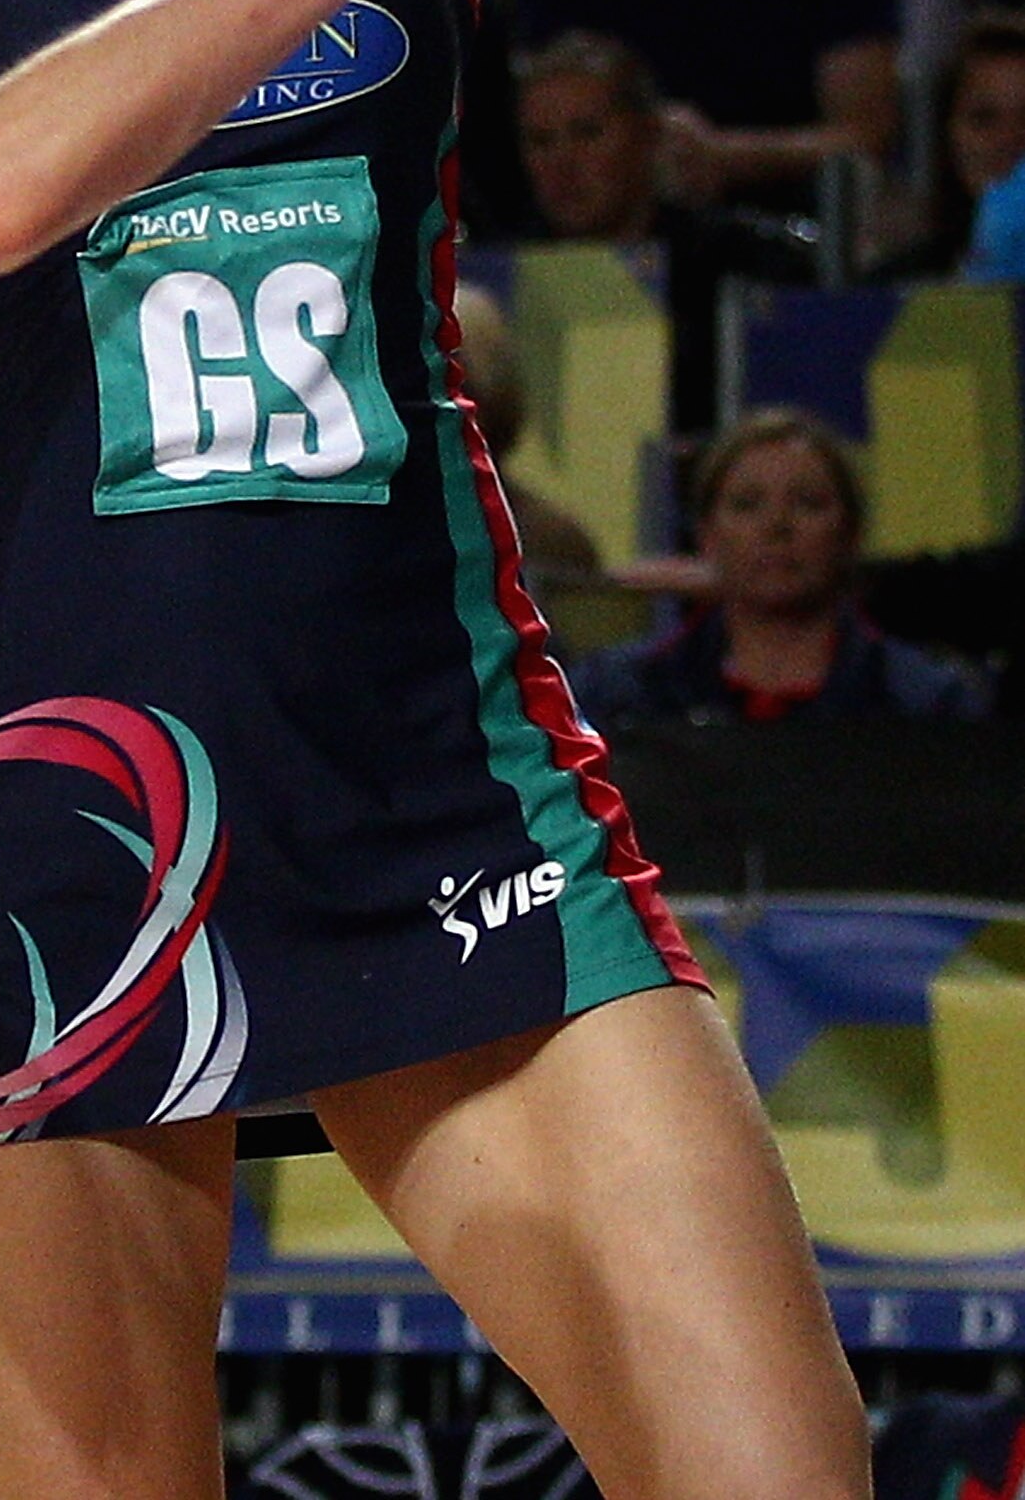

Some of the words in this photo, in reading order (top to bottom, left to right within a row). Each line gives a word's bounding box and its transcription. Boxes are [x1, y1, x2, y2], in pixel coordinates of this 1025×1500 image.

[233, 78, 335, 109] ING
[218, 201, 342, 234] Resorts
[138, 261, 365, 481] GS
[478, 861, 566, 929] VIS
